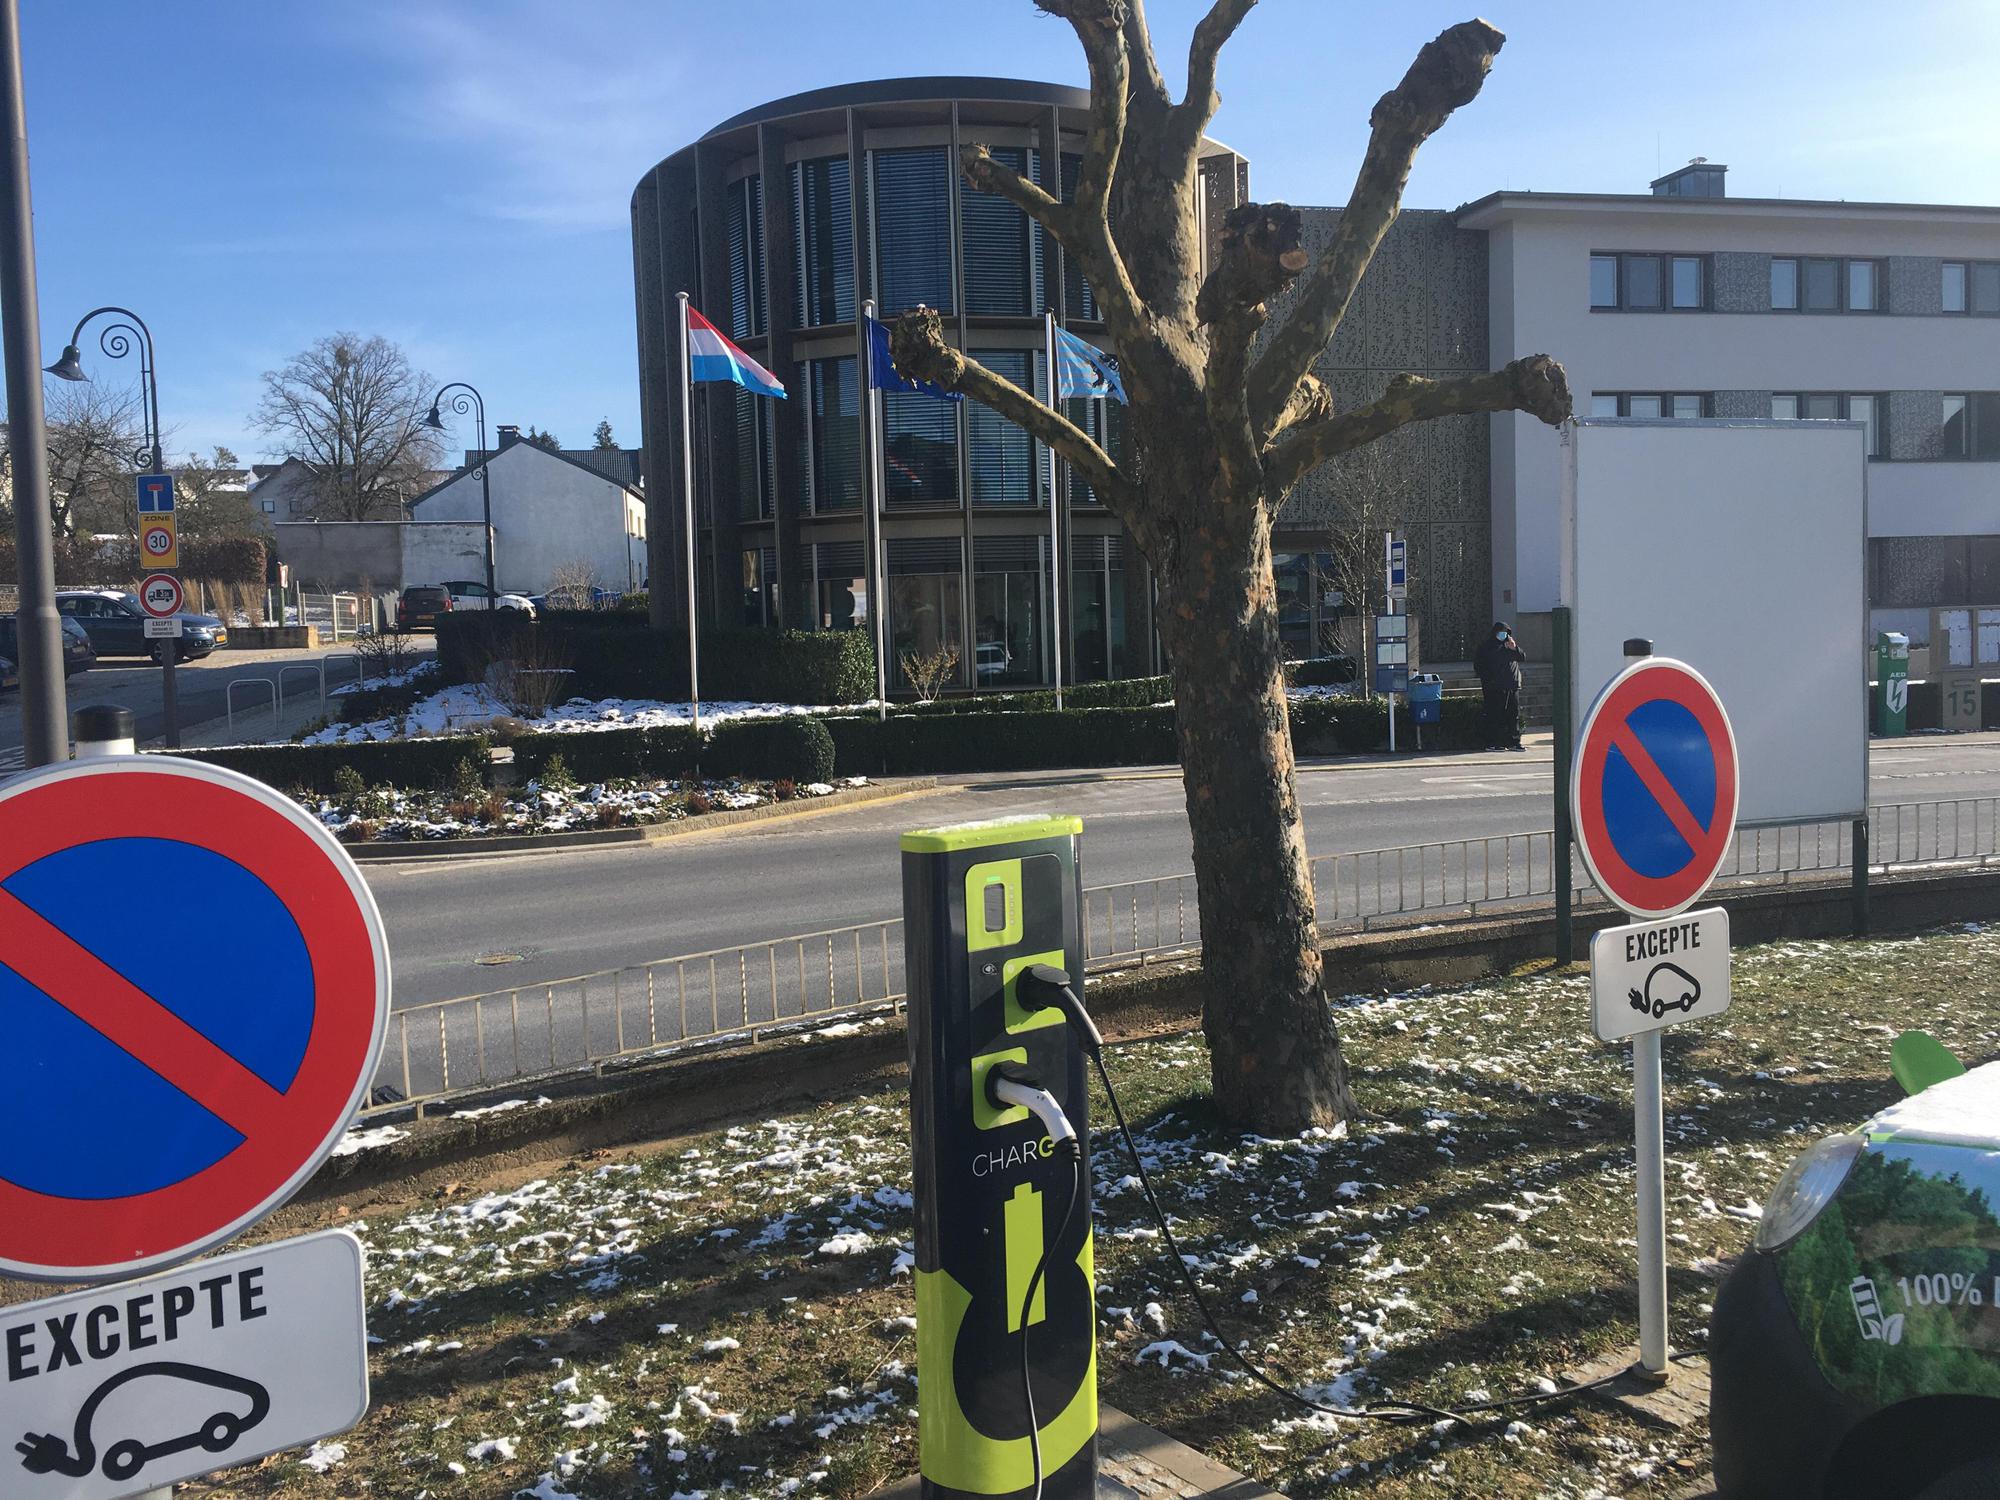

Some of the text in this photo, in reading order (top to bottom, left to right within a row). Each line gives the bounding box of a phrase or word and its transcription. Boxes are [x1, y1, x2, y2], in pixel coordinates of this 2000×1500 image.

[150, 535, 167, 549] 30
[1947, 690, 1977, 717] 15
[1625, 921, 1701, 962] EXCEPTE
[1896, 1272, 1983, 1307] 100%
[6, 1266, 267, 1382] EXCEPTE
